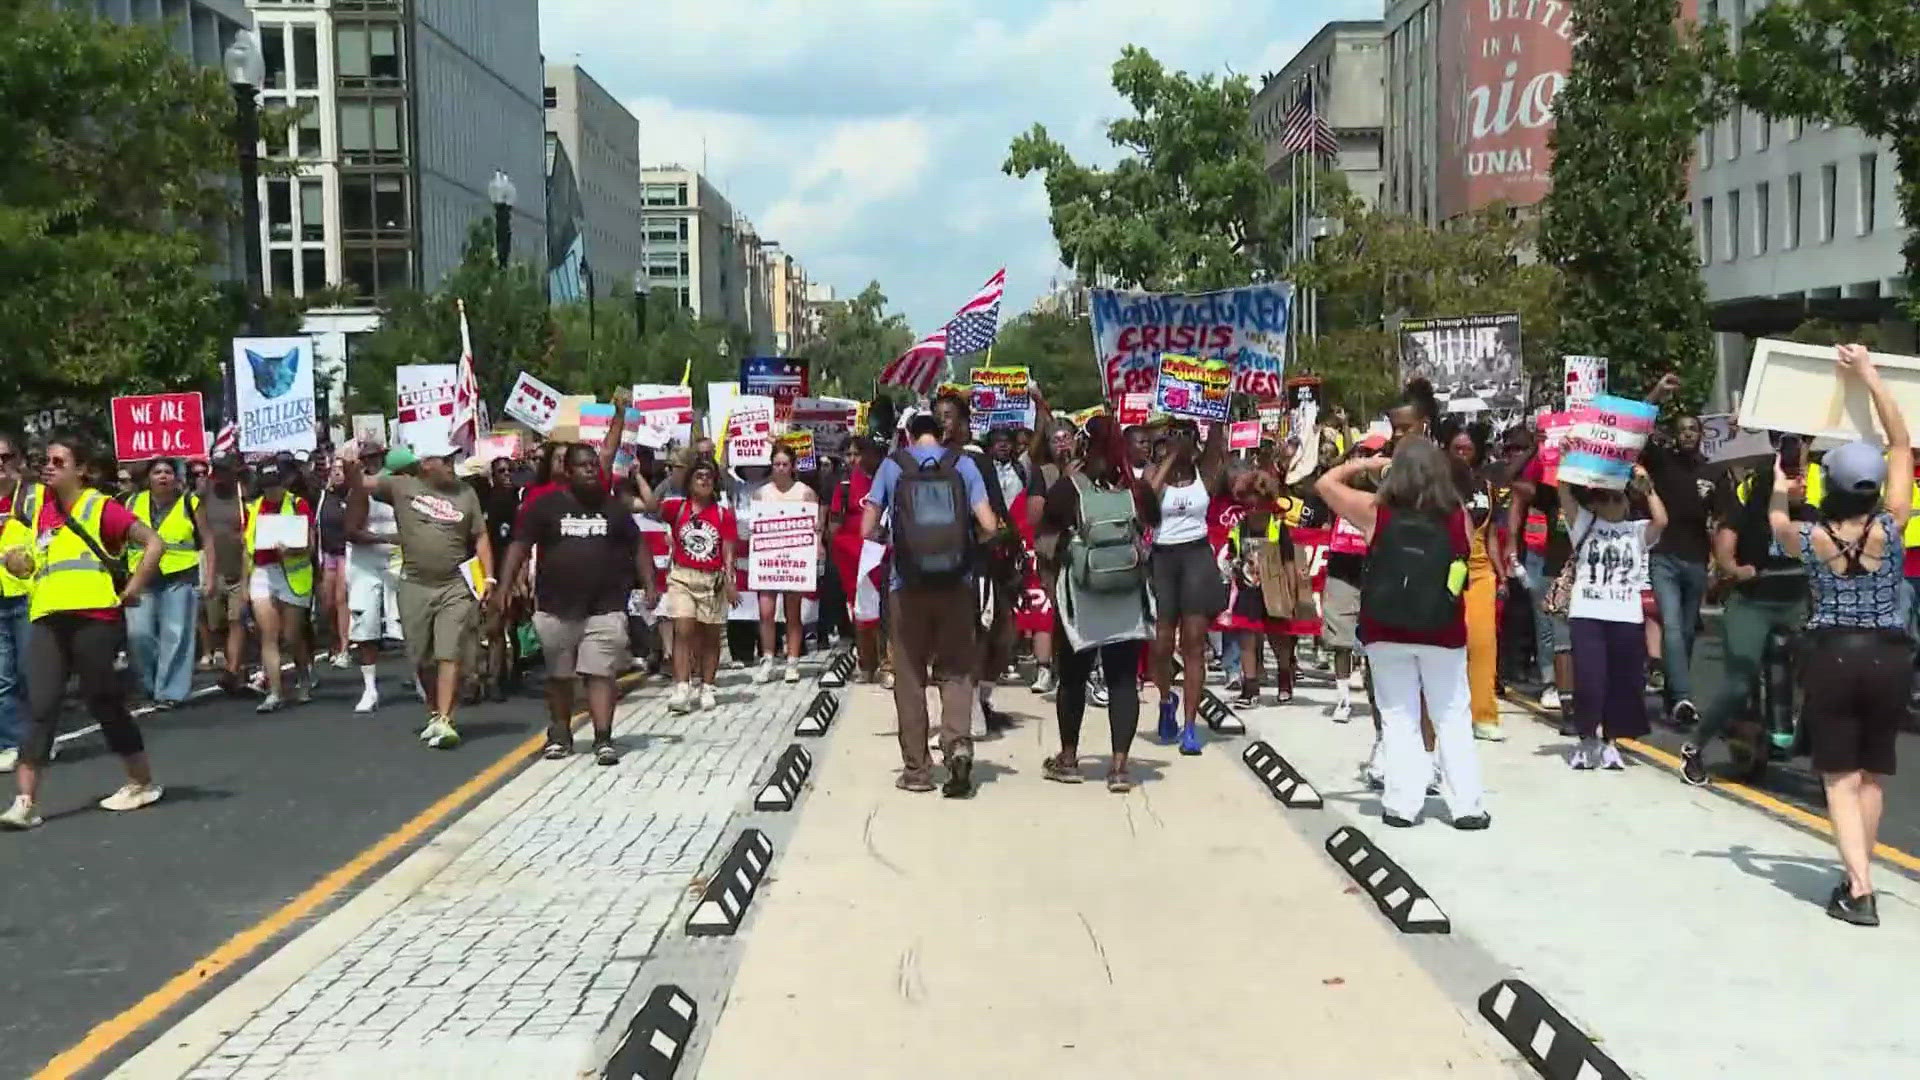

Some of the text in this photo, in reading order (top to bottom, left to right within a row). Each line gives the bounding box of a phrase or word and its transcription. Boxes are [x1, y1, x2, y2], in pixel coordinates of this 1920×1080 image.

[1482, 32, 1521, 58] IN A
[1466, 60, 1570, 140] nio
[1118, 325, 1234, 352] CRISIS
[131, 400, 185, 424] WE ARE
[1598, 413, 1617, 426] NO
[132, 429, 191, 451] ALL D.C.
[734, 439, 766, 448] HOME
[736, 448, 763, 457] RULE
